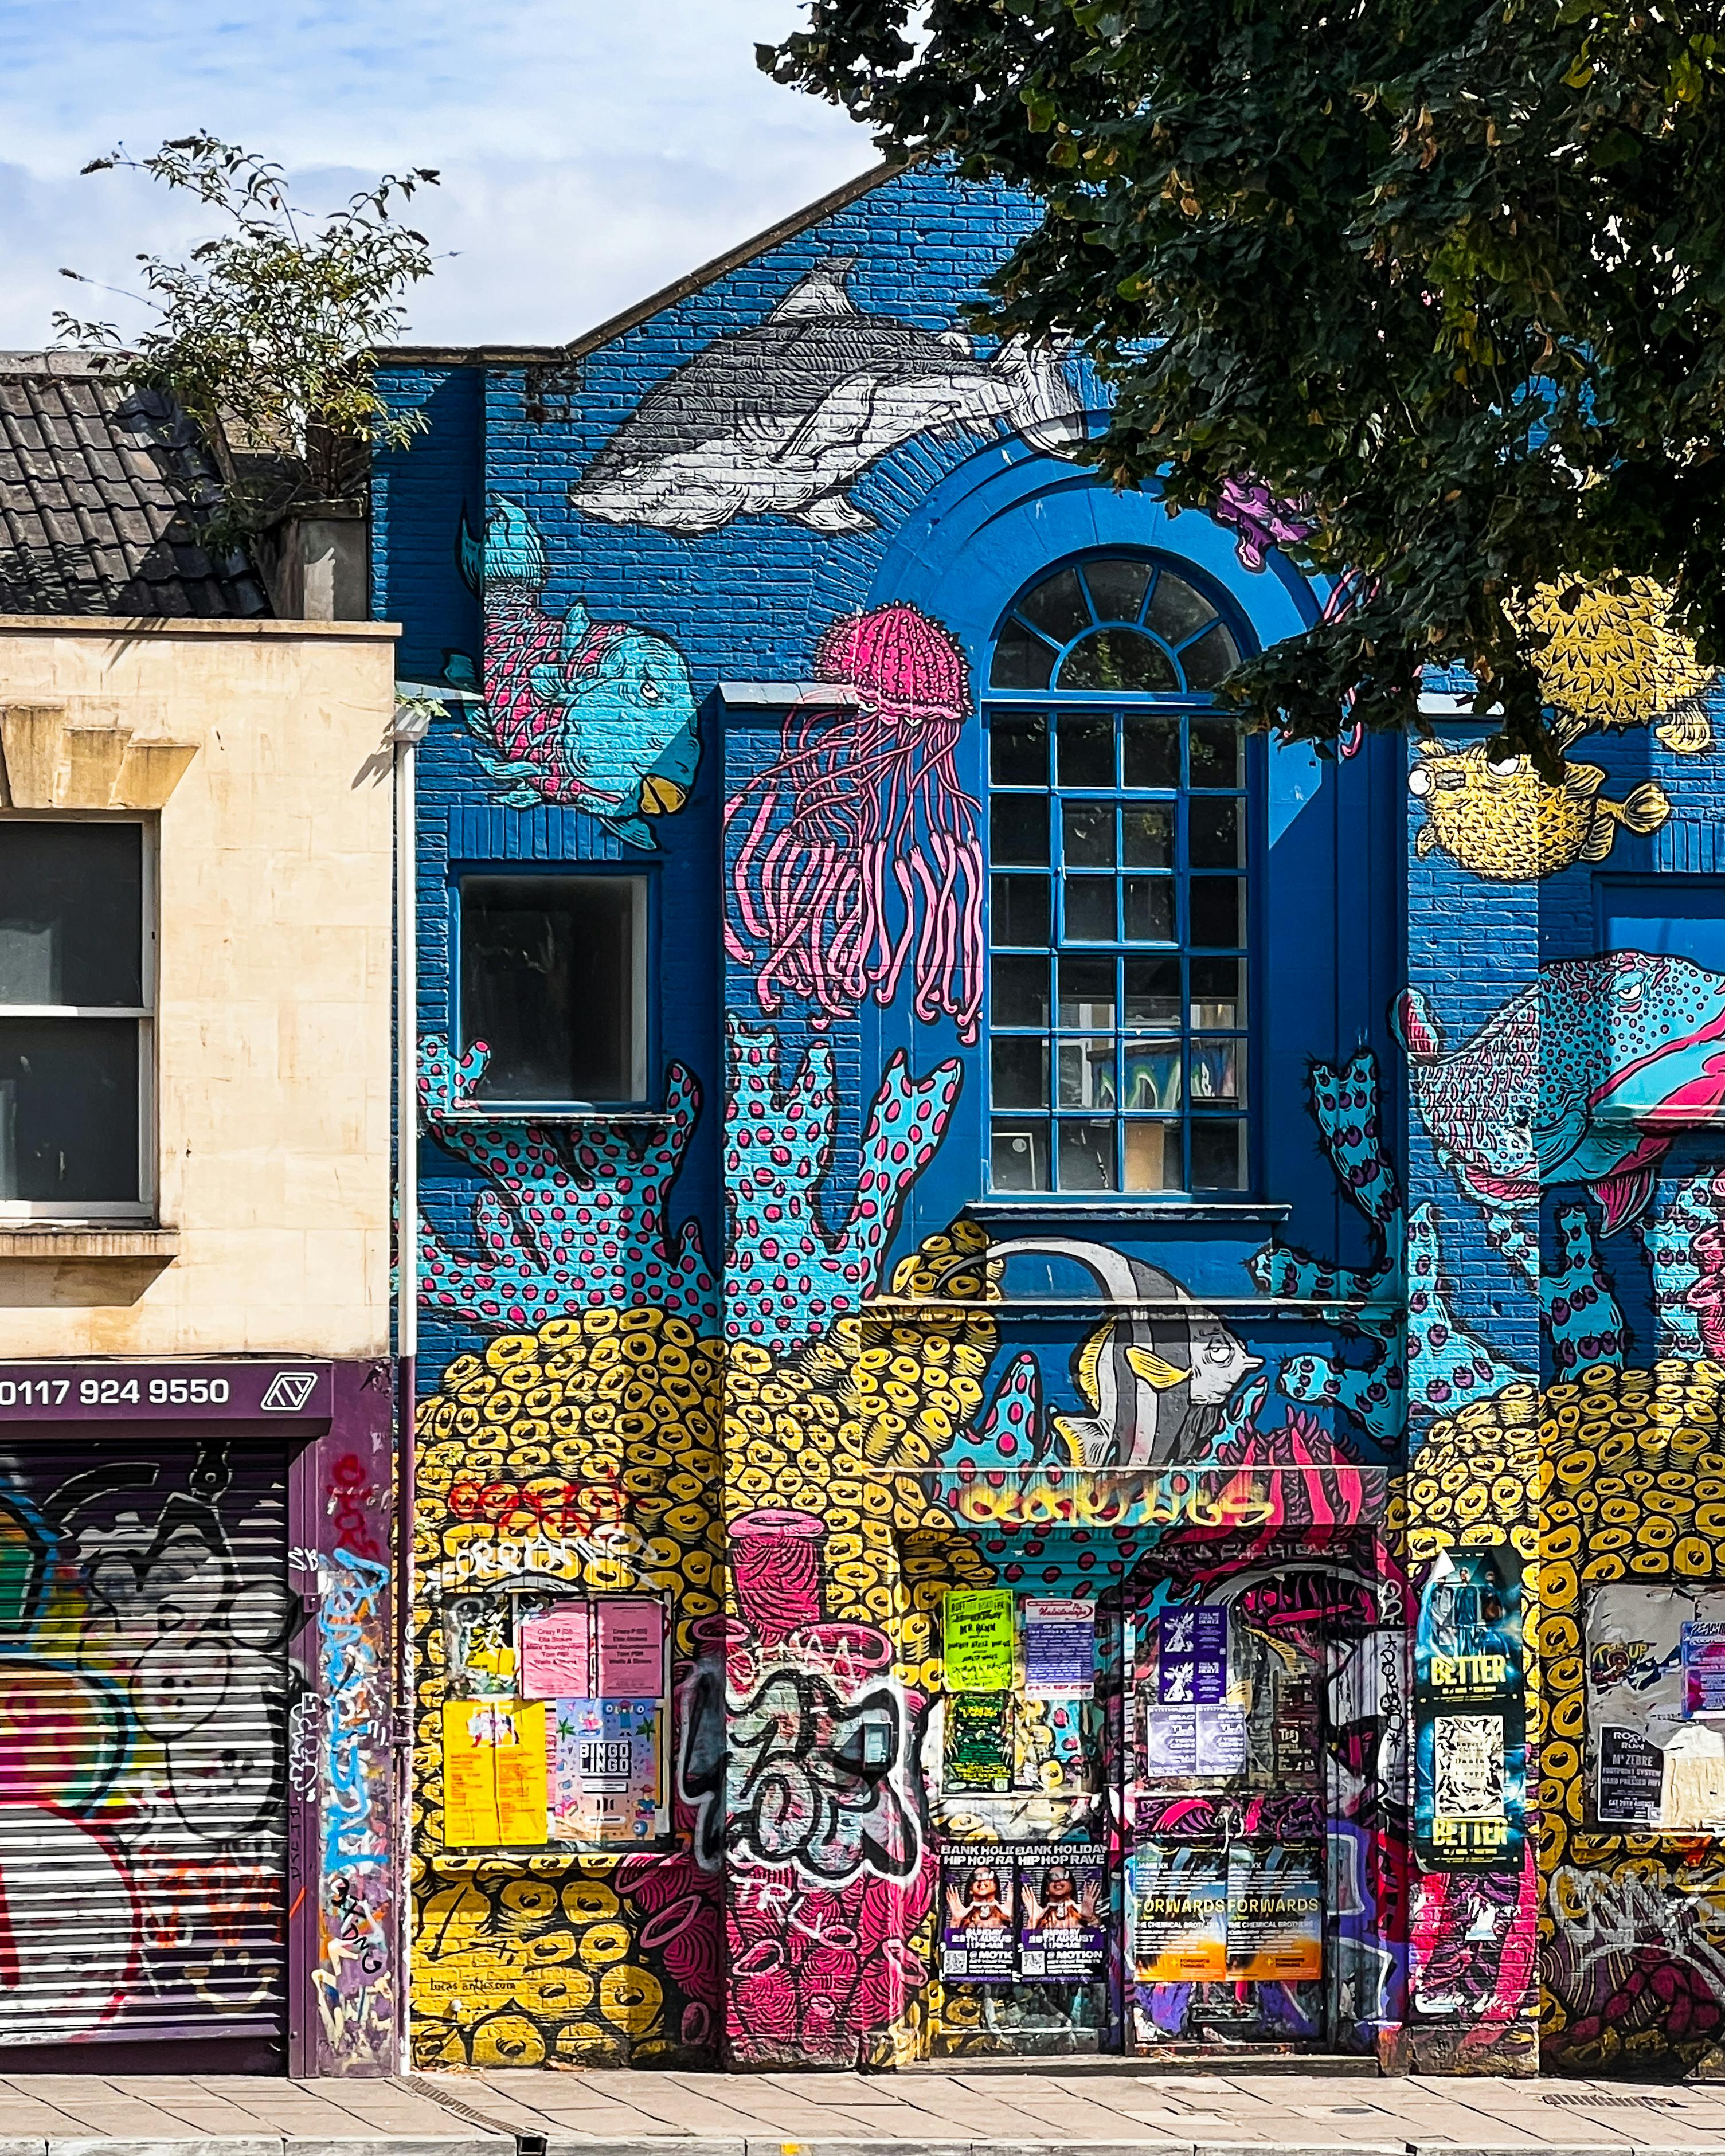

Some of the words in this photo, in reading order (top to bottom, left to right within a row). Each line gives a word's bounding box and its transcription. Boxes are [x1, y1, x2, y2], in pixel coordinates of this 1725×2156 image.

[0, 1380, 69, 1405] 0117
[80, 1380, 139, 1403] 924
[149, 1379, 229, 1403] 9550
[1431, 1654, 1507, 1685] BETTER
[579, 1744, 629, 1758] BINGO
[579, 1758, 629, 1772] LINGO
[1433, 1817, 1508, 1846] BETTER
[941, 1845, 979, 1855] BANK
[1015, 1845, 1052, 1855] BANK
[1053, 1844, 1108, 1854] HOLIDAY
[944, 1855, 966, 1865] HIP
[967, 1856, 995, 1865] HOP
[1018, 1856, 1040, 1865] HIP
[1041, 1855, 1069, 1865] HOP
[1070, 1854, 1105, 1864] RAVE
[1135, 1899, 1225, 1913] FORWARDS
[1227, 1898, 1319, 1912] FORWARDS
[1056, 1934, 1095, 1943] AUGUST
[1056, 1951, 1103, 1959] MOTION
